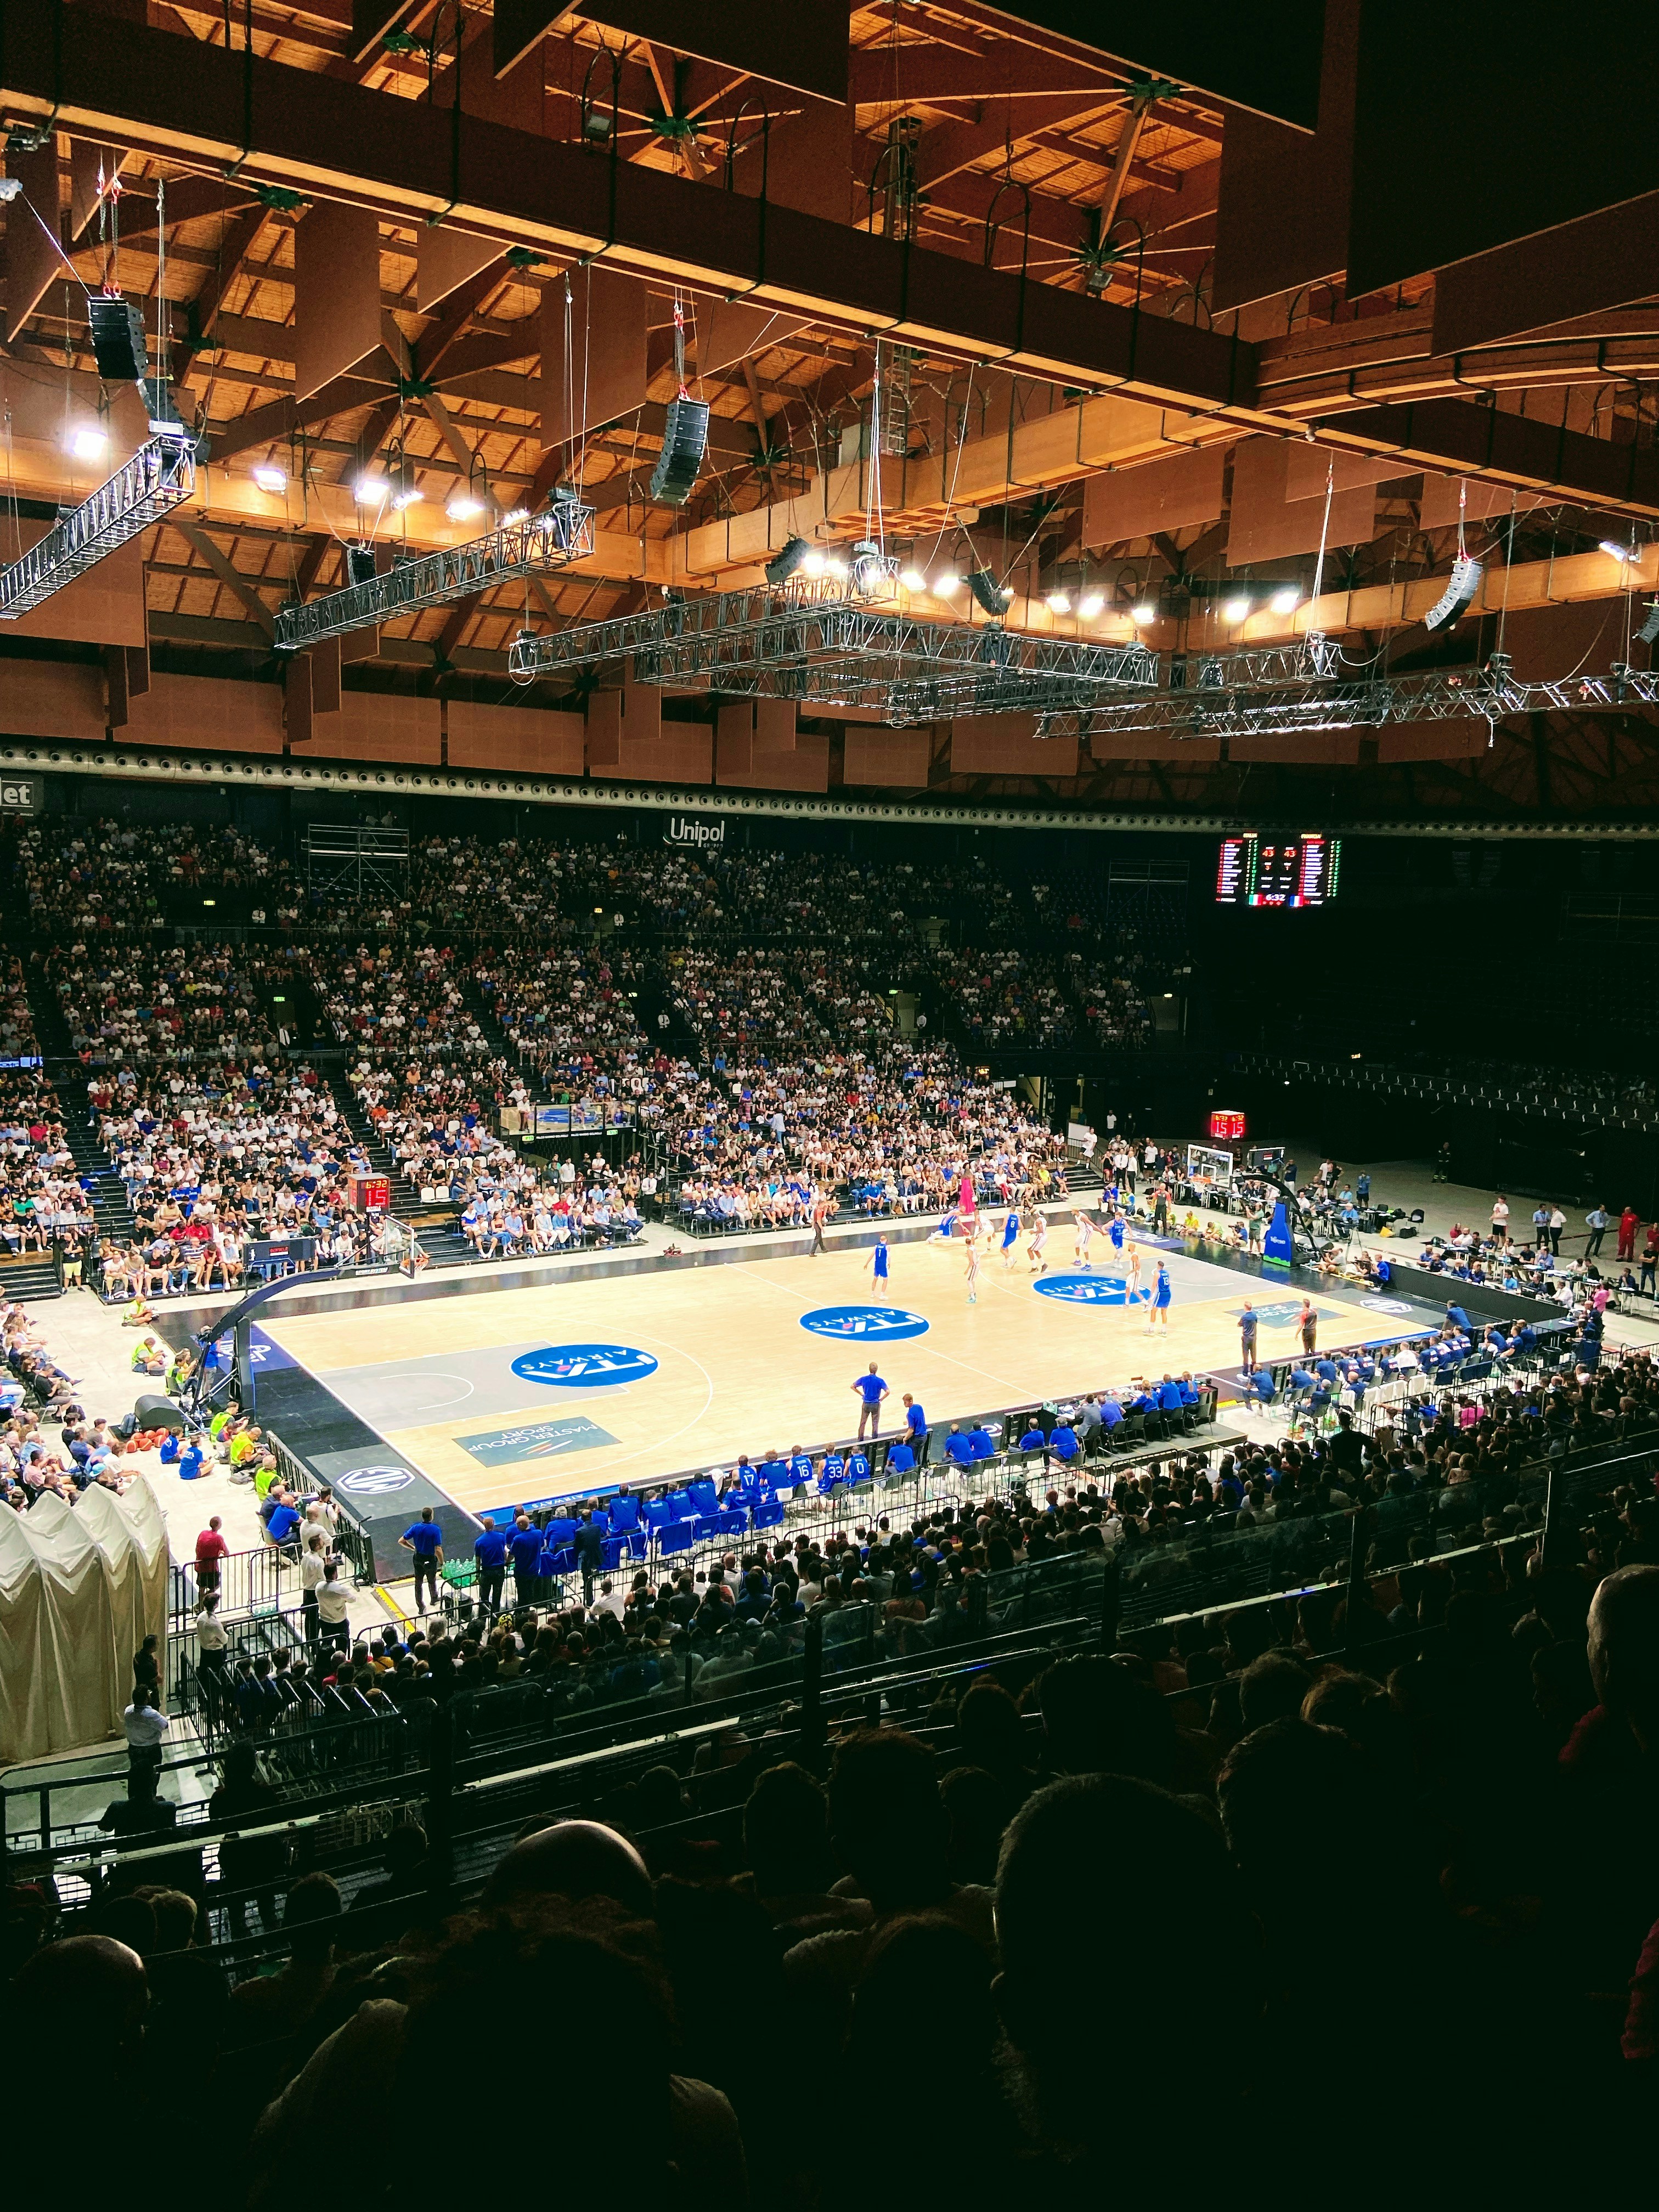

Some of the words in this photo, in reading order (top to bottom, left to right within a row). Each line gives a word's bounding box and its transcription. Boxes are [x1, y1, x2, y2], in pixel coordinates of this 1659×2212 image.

[671, 817, 725, 847] Unipol
[1216, 1121, 1228, 1135] 15
[1233, 1121, 1244, 1134] 15
[366, 1180, 387, 1189] 6:32
[368, 1189, 386, 1206] 15
[878, 1249, 882, 1257] 1
[1043, 1279, 1117, 1293] AIRWAYS
[1163, 1277, 1169, 1285] 13
[809, 1310, 896, 1327] AIRWAYS
[521, 1350, 627, 1370] AIRWAYS
[501, 1425, 554, 1440] SPORT
[532, 1424, 599, 1440] MASTER
[468, 1436, 530, 1452] GROUP
[797, 1465, 809, 1478] 16
[828, 1466, 843, 1479] 33
[856, 1463, 865, 1474] 0
[743, 1474, 754, 1486] 17
[531, 1494, 584, 1509] AIRWAYS
